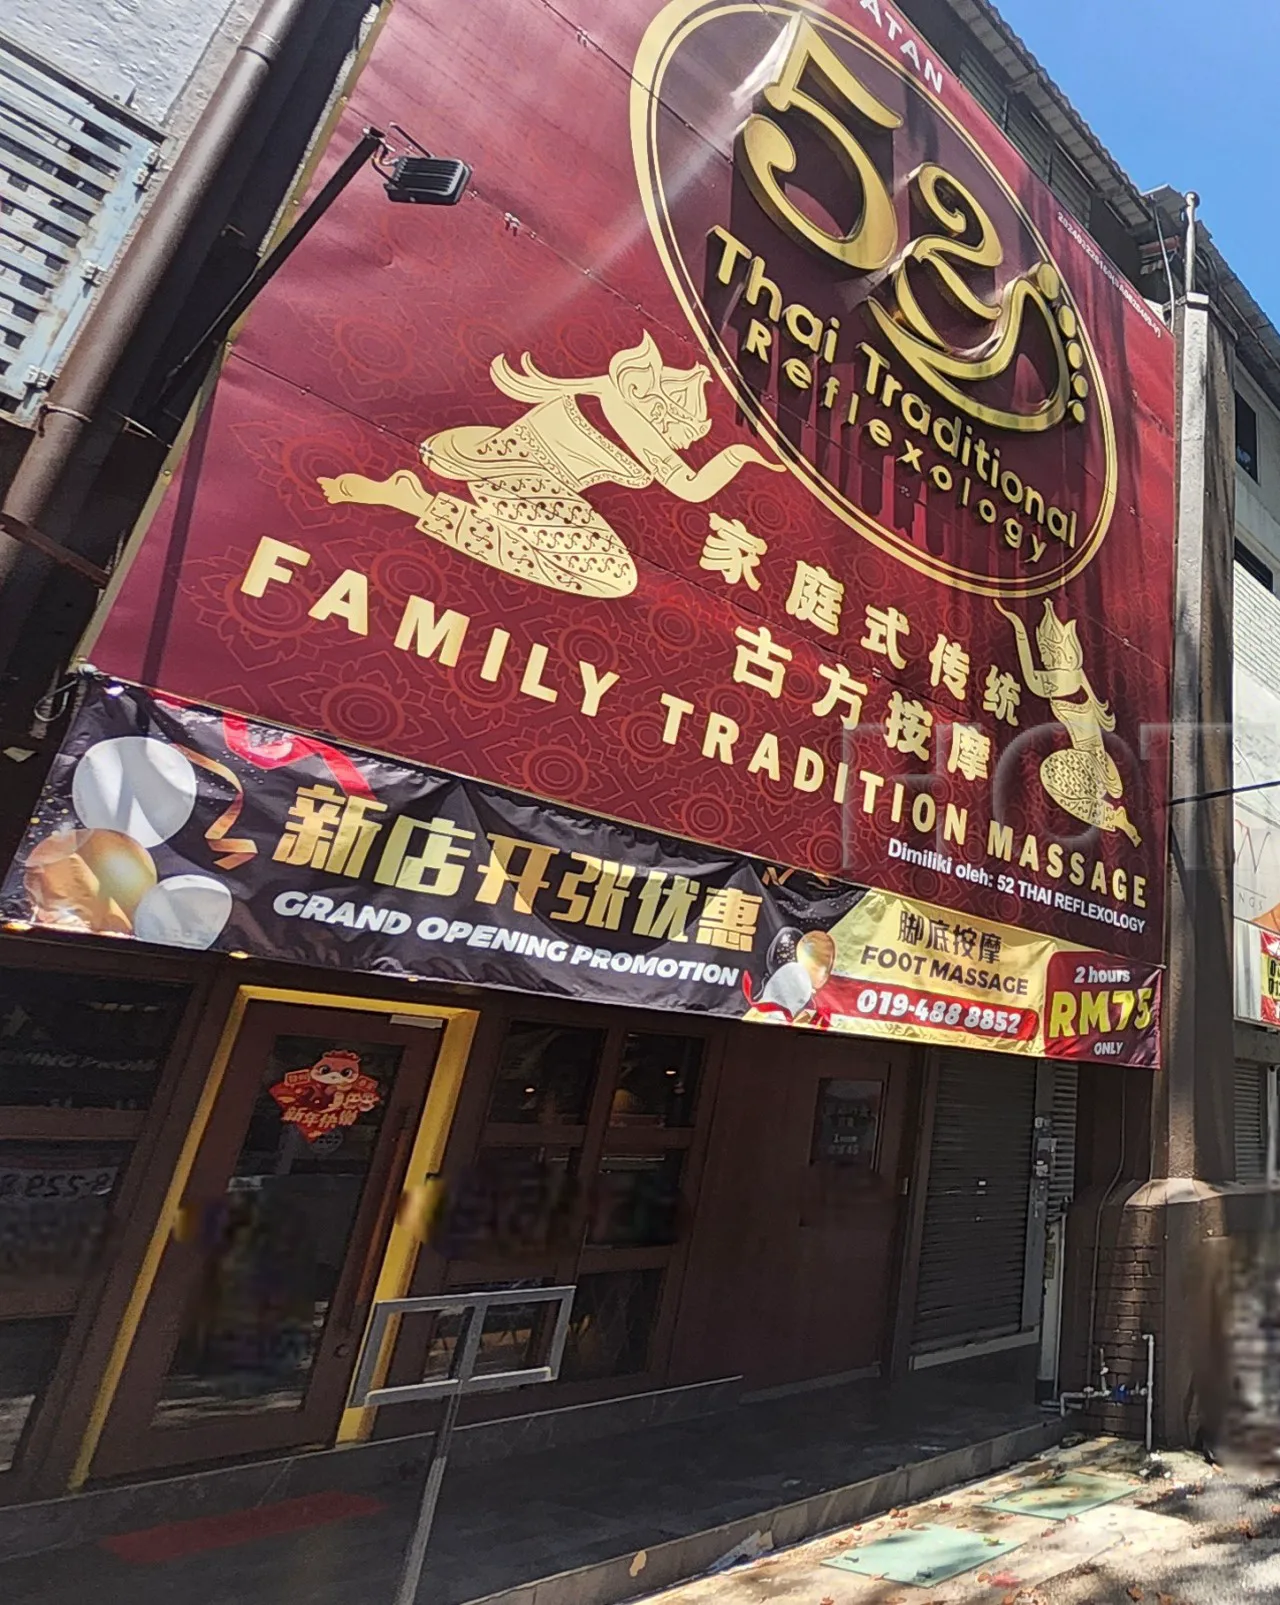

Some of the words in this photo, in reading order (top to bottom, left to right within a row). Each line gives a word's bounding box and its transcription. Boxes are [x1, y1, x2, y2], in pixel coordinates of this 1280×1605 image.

[705, 225, 840, 363] Thai
[857, 342, 1077, 549] Traditional
[742, 318, 1047, 563] Reflexology
[699, 512, 1022, 727] 家庭式传统
[240, 535, 620, 718] FAMILY
[660, 693, 968, 846] TRADITION
[986, 818, 1148, 909] MASSAGE
[732, 625, 992, 781] 古方按摩
[271, 783, 764, 953] 新店开张优惠
[888, 836, 953, 876] Dimiliki
[955, 861, 994, 890] oleh:
[996, 873, 1016, 895] 52
[1017, 882, 1053, 906] THAI
[1053, 893, 1146, 934] REFLEXOLOGY
[272, 890, 412, 935] GRAND
[416, 916, 569, 962] OPENING
[570, 945, 739, 987] PROMOTION
[861, 945, 929, 976] FOOT
[929, 959, 1029, 995] MASSAGE
[897, 911, 1002, 964] 脚底按摩
[1074, 966, 1086, 983] 2
[1087, 966, 1131, 983] hours
[856, 988, 963, 1024] 019-488
[964, 1006, 1021, 1034] 8852
[1049, 987, 1153, 1040] RM75
[1093, 1041, 1124, 1056] ONLY
